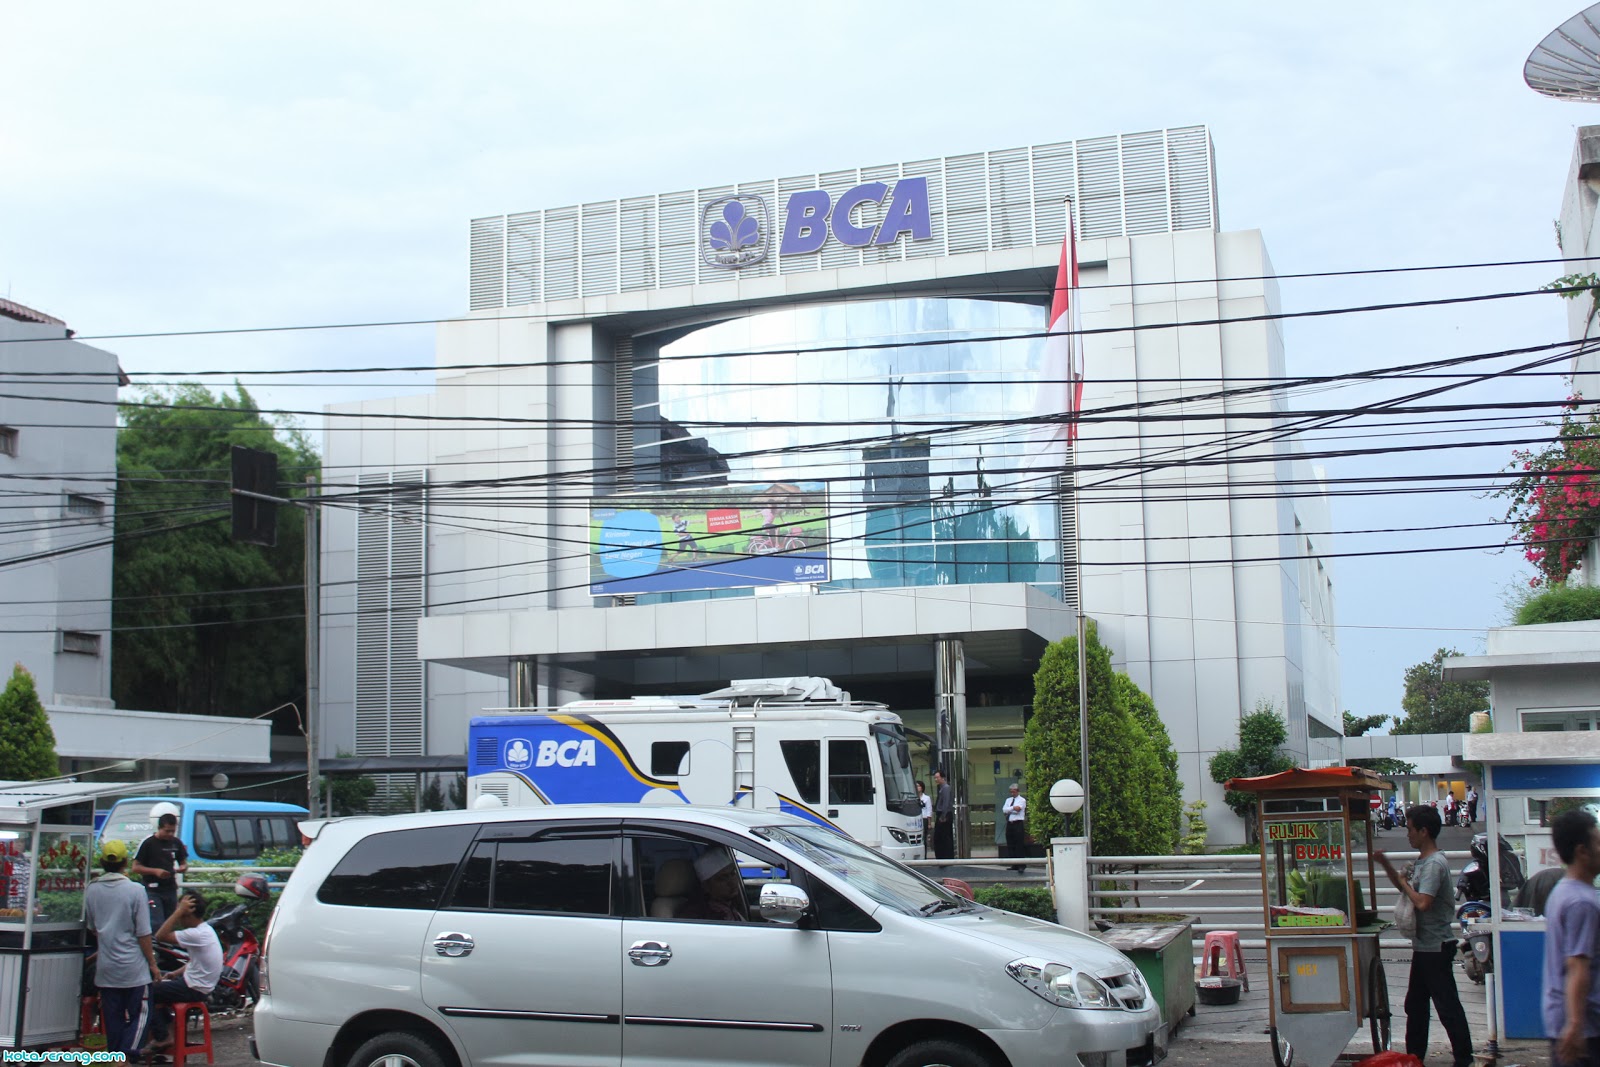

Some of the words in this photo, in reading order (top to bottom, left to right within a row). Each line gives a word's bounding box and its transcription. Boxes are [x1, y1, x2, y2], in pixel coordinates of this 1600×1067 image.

[779, 176, 933, 256] BCA
[804, 564, 825, 575] BCA
[535, 739, 596, 768] BCA
[1268, 822, 1319, 840] RUJAK
[1294, 844, 1343, 860] BUAH
[1278, 915, 1345, 927] CIREBON
